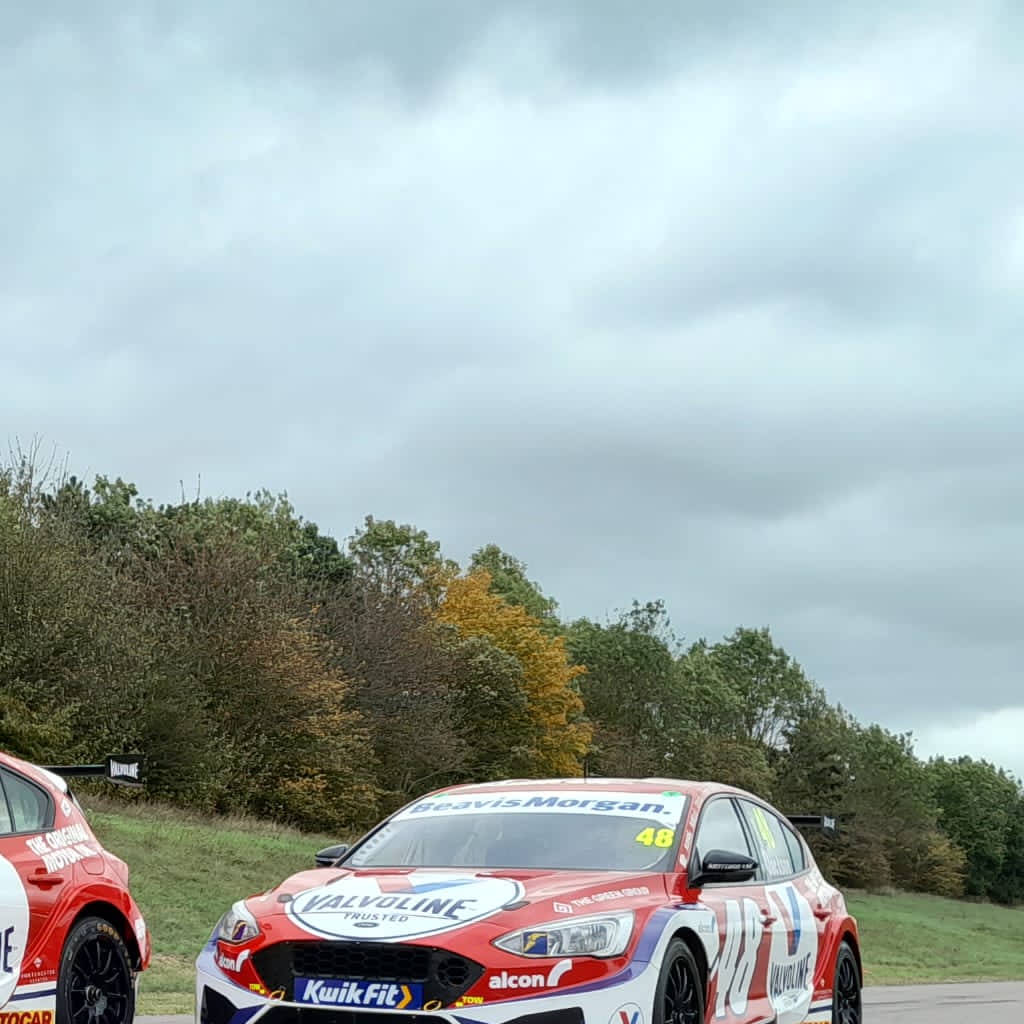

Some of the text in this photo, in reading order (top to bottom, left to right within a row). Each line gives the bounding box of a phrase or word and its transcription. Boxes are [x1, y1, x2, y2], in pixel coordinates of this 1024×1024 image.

[635, 828, 675, 848] 48
[301, 894, 477, 920] VALVOLINE
[343, 912, 409, 922] TRUSTED
[488, 971, 545, 988] alcon
[462, 996, 484, 1004] TOW
